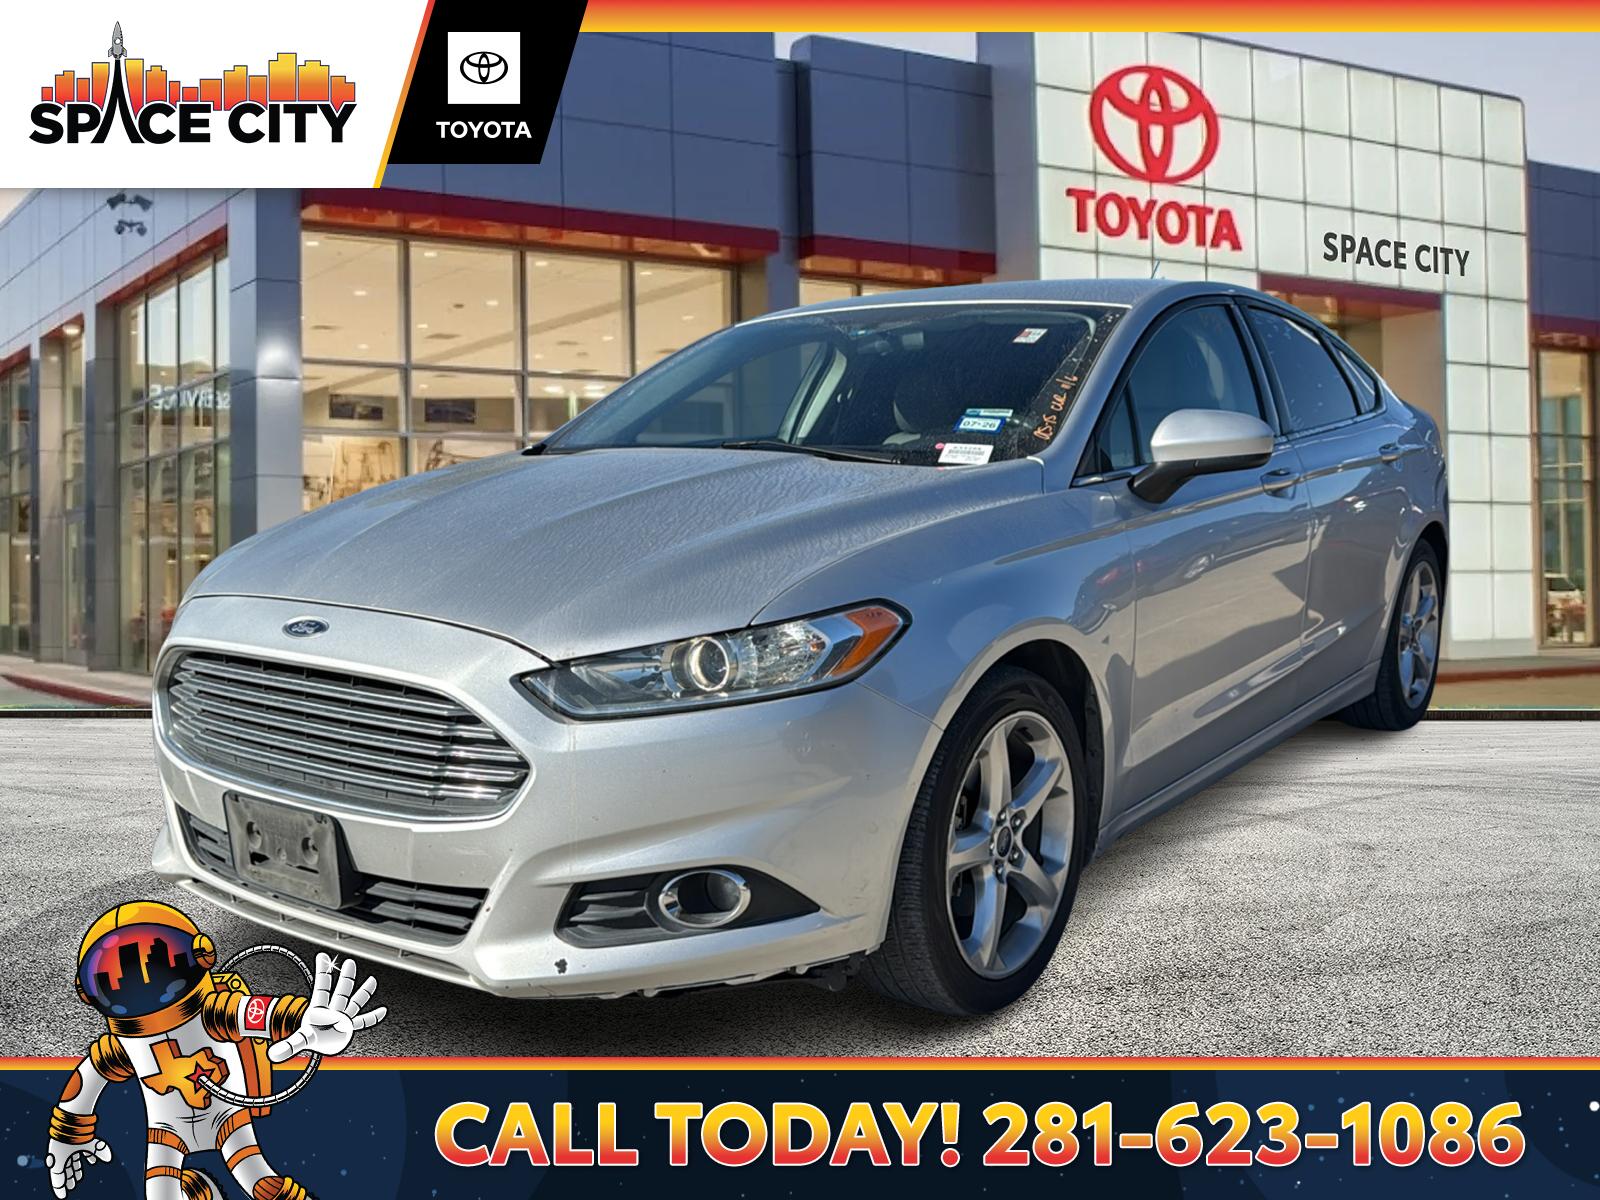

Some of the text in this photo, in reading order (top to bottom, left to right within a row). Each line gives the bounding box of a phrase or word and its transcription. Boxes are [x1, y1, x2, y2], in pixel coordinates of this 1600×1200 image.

[1066, 188, 1243, 251] TOYOTA
[1322, 231, 1471, 277] SPACE CITY
